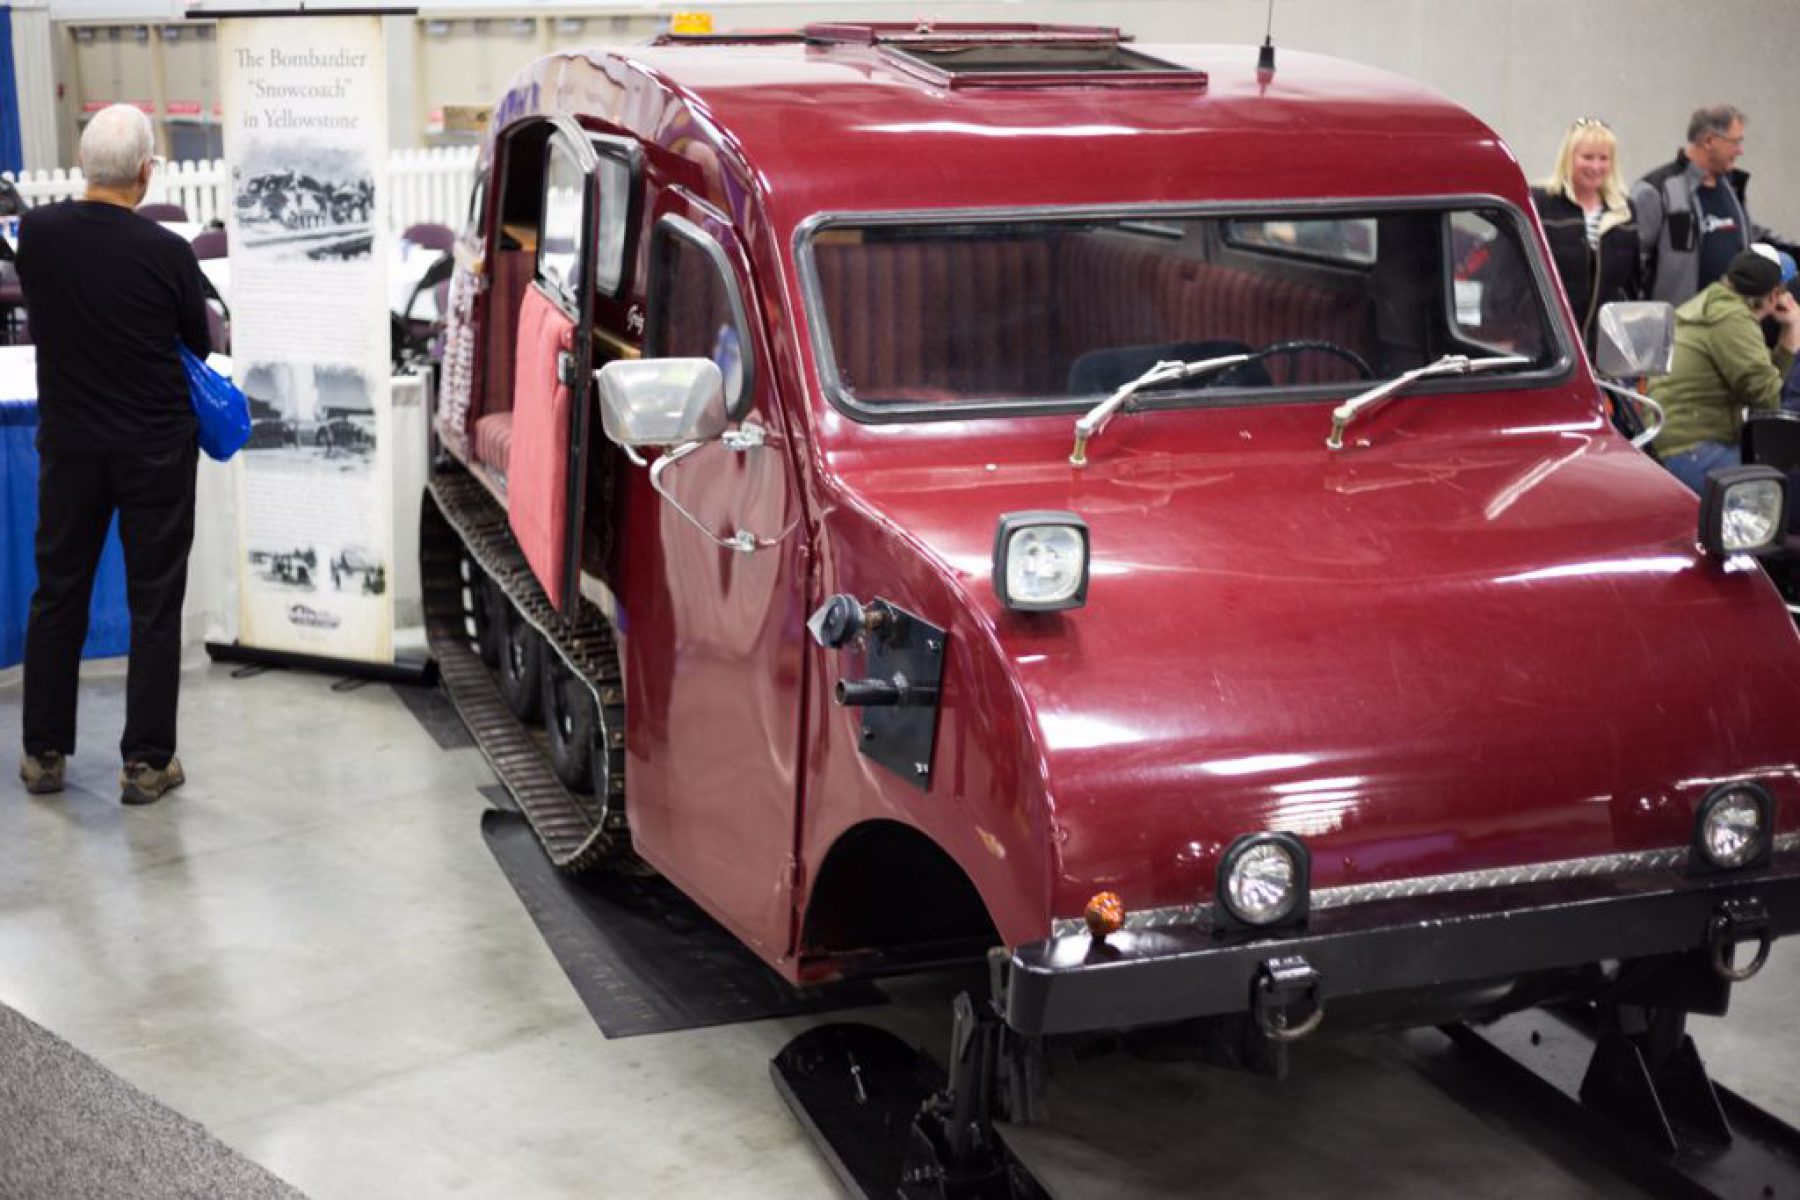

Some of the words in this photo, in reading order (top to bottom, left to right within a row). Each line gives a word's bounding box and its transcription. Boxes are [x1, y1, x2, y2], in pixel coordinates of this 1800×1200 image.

[234, 48, 264, 68] The
[270, 47, 366, 68] Bombardier
[249, 78, 352, 98] “Snowcoach”
[244, 110, 258, 129] in
[265, 109, 358, 129] Yellowstone
